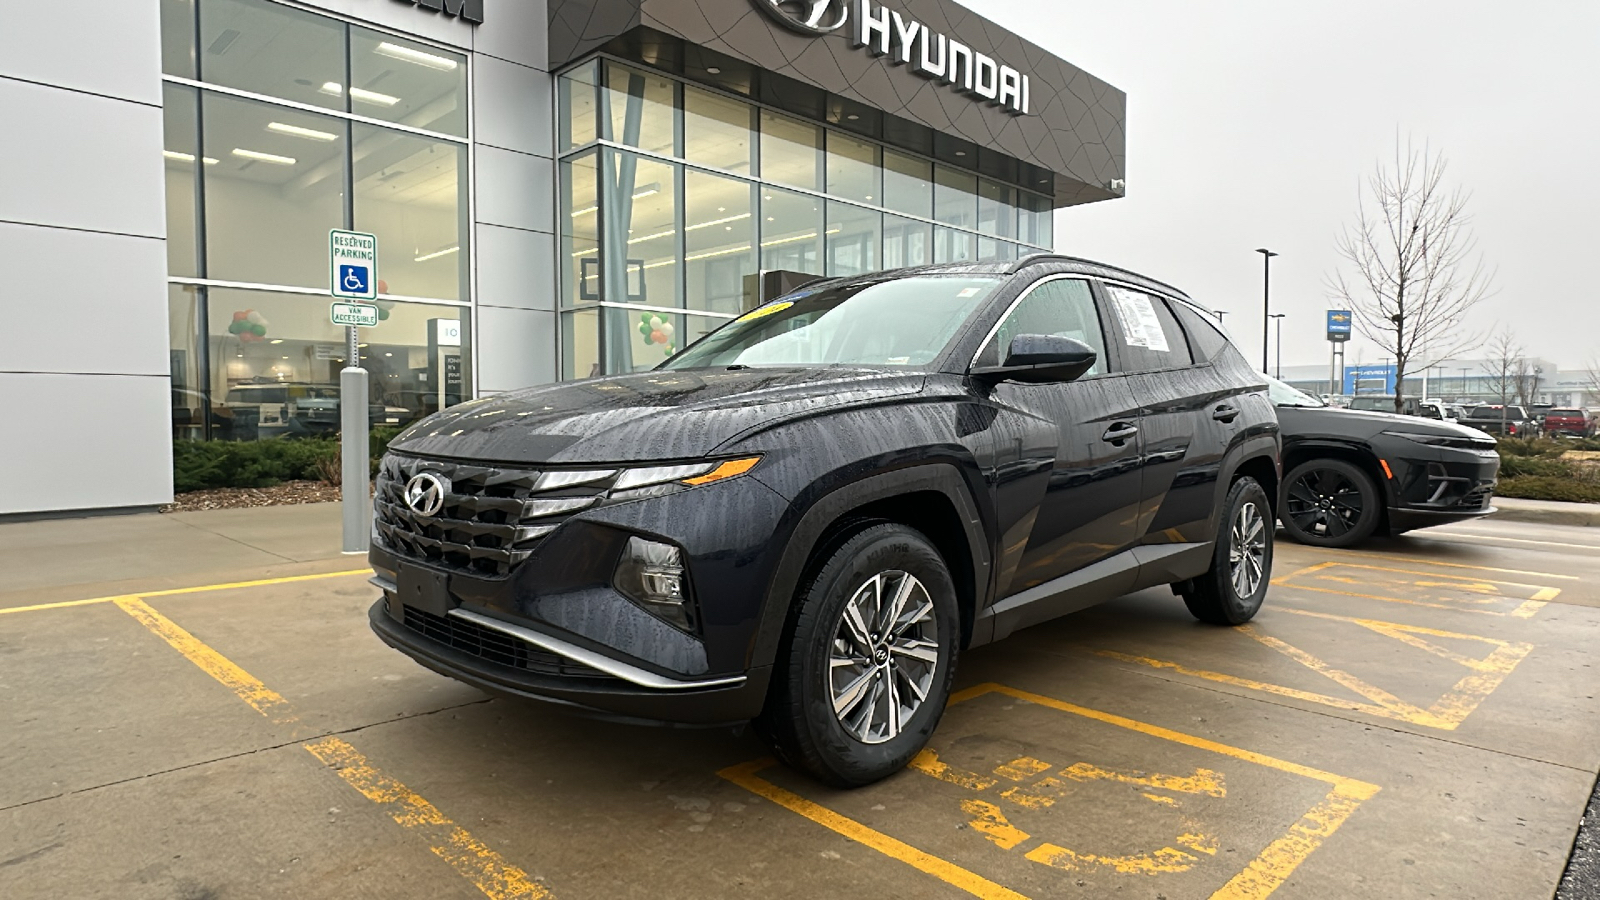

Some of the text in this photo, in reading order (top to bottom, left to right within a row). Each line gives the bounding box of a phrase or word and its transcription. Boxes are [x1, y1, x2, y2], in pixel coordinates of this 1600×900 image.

[854, 0, 1030, 115] HYUNDAI
[334, 236, 373, 249] RESERVED
[334, 247, 373, 261] PARKING
[334, 314, 375, 323] ACCESSIBLE
